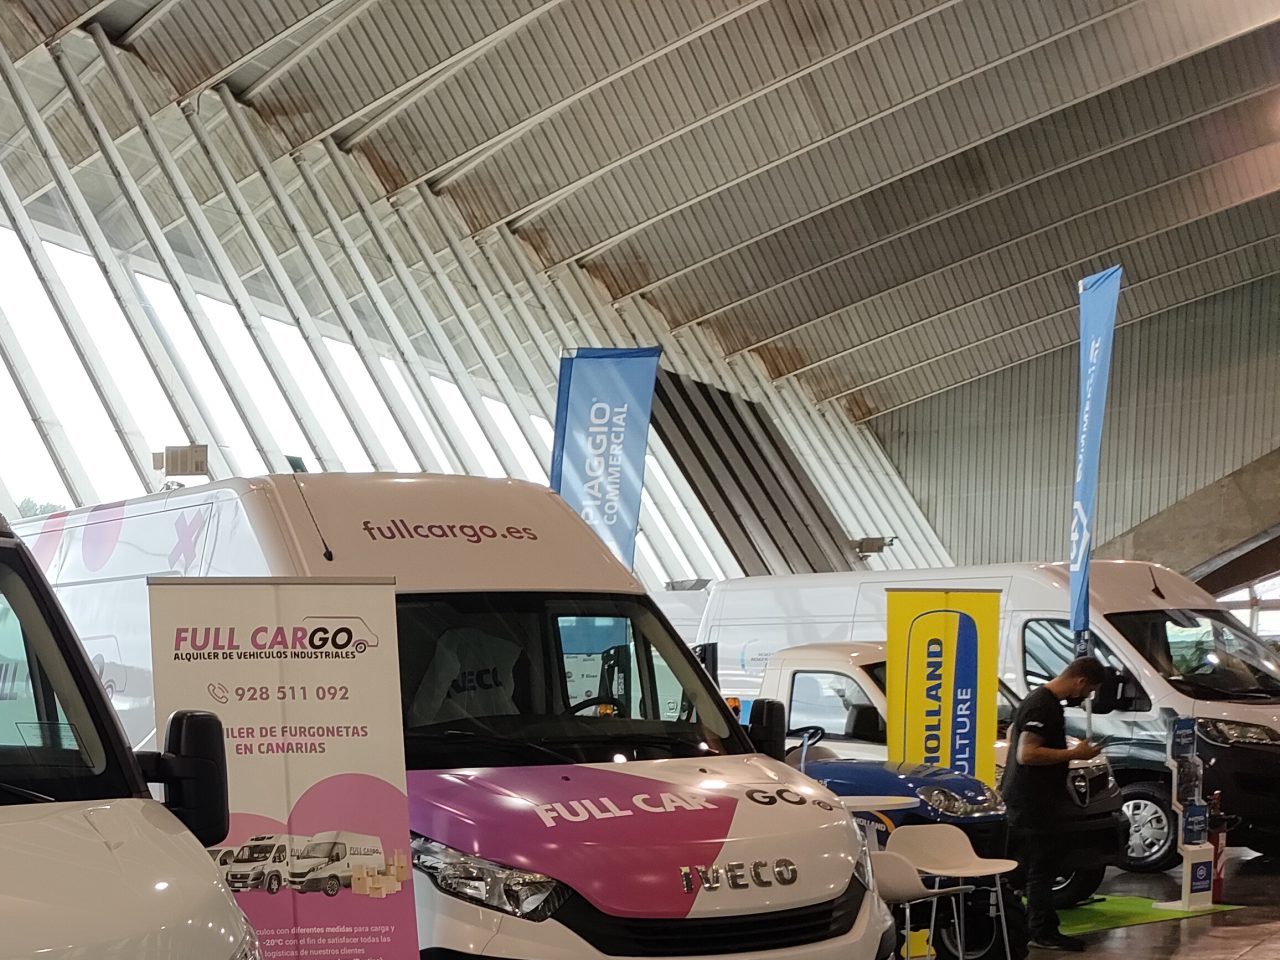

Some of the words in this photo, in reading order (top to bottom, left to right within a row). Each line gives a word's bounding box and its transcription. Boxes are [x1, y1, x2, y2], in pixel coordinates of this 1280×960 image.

[581, 402, 610, 525] PIAGGIO
[603, 403, 628, 525] COMMERCIAL
[363, 519, 538, 544] fullcargo.es
[174, 627, 240, 651] FULL
[250, 626, 353, 651] CARGO
[173, 652, 220, 662] ALQUILER
[222, 651, 234, 660] DE
[237, 651, 288, 660] VEHICULOS
[290, 651, 356, 660] INDUSTRIALES
[234, 686, 270, 701] 928
[277, 686, 307, 701] 511
[315, 686, 349, 701] 092
[225, 727, 255, 739] ILER
[259, 727, 278, 738] DE
[281, 725, 369, 738] FURGONETAS
[955, 688, 972, 776] ULTURE
[235, 743, 254, 755] EN
[257, 742, 326, 755] CANARIAS
[534, 797, 635, 828] FULL
[678, 857, 798, 894] IVECO
[256, 927, 275, 936] culos
[276, 927, 290, 935] con
[291, 926, 325, 935] diferentes
[326, 925, 353, 933] medidas
[353, 925, 369, 935] para
[370, 925, 389, 935] carga
[390, 925, 395, 933] y
[299, 936, 305, 945] el
[306, 936, 316, 945] fin
[317, 936, 326, 944] de
[327, 935, 359, 944] satisfacer
[360, 935, 379, 943] todas
[380, 935, 391, 943] las
[300, 948, 308, 956] de
[309, 948, 339, 956] nuestros
[340, 946, 365, 954] clientes
